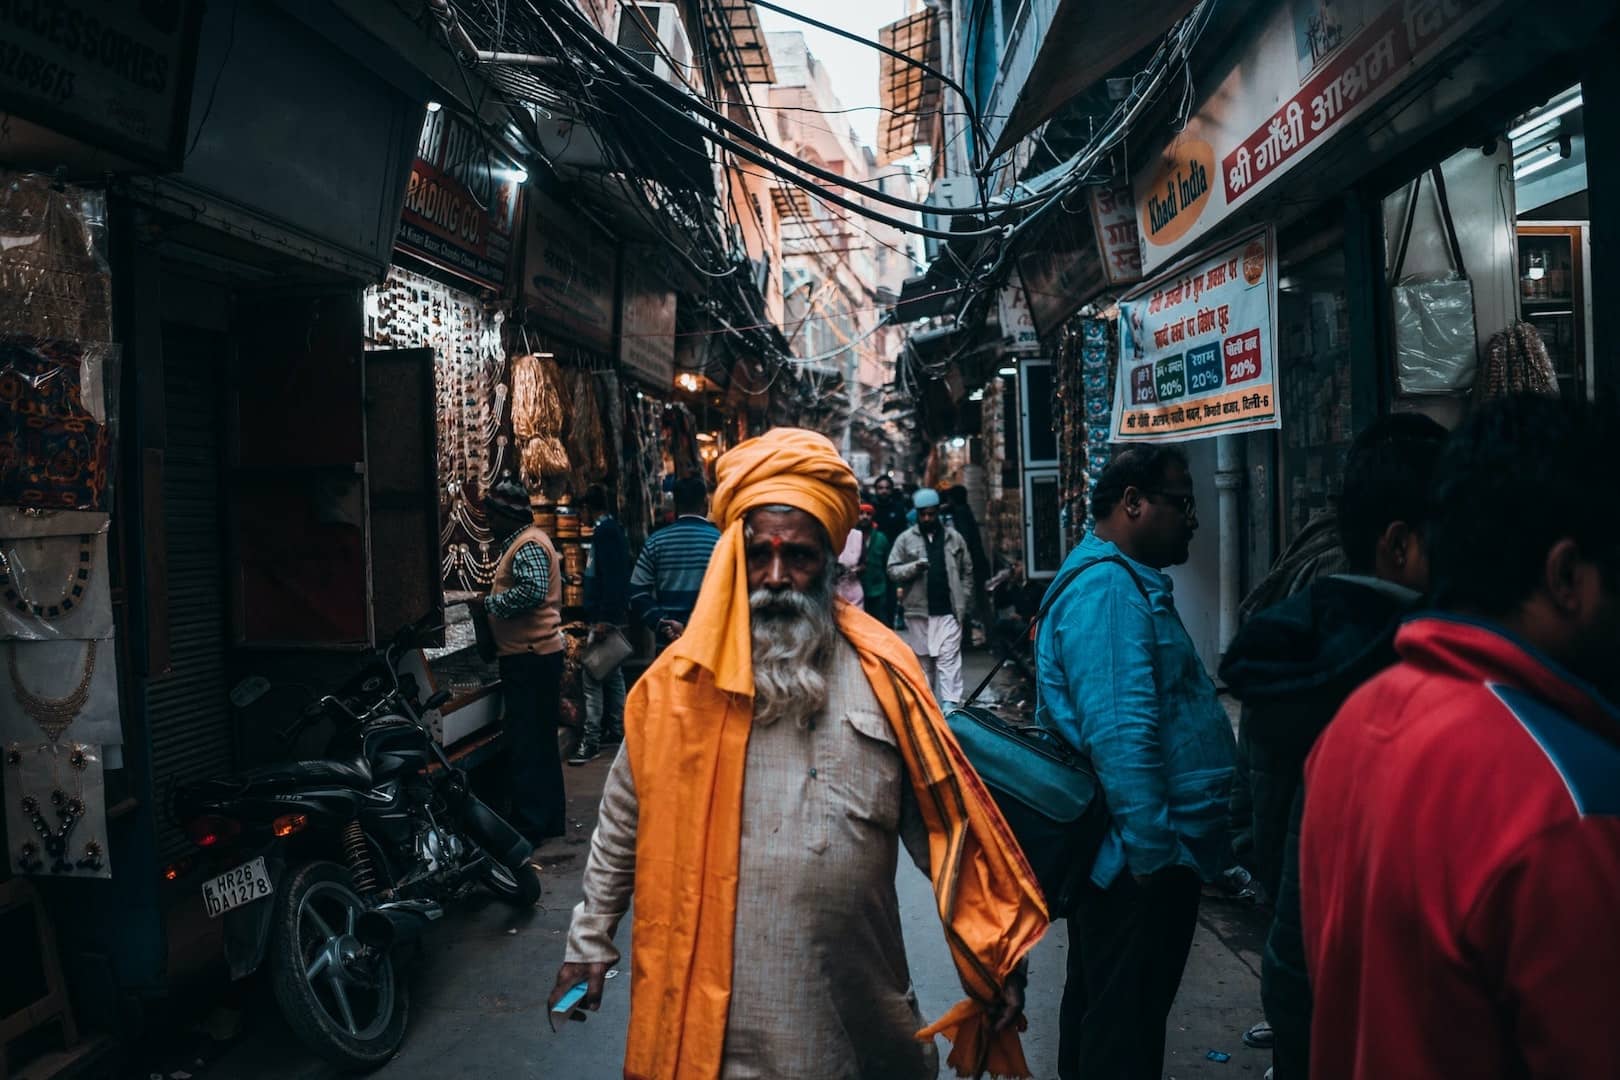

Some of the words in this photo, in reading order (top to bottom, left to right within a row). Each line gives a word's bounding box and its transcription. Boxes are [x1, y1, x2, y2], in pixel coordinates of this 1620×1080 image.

[1229, 146, 1251, 193] श्री
[1254, 101, 1305, 171] गाँधी
[1310, 28, 1396, 131] आश्रम
[1148, 181, 1178, 235] Khadi
[1177, 159, 1208, 211] India
[1229, 257, 1238, 280] पर
[1187, 318, 1195, 337] पर
[1192, 368, 1218, 389] 20%
[1230, 358, 1256, 380] 20%
[1160, 378, 1182, 397] 20%
[217, 865, 253, 893] HR26
[213, 878, 268, 914] DA1278
